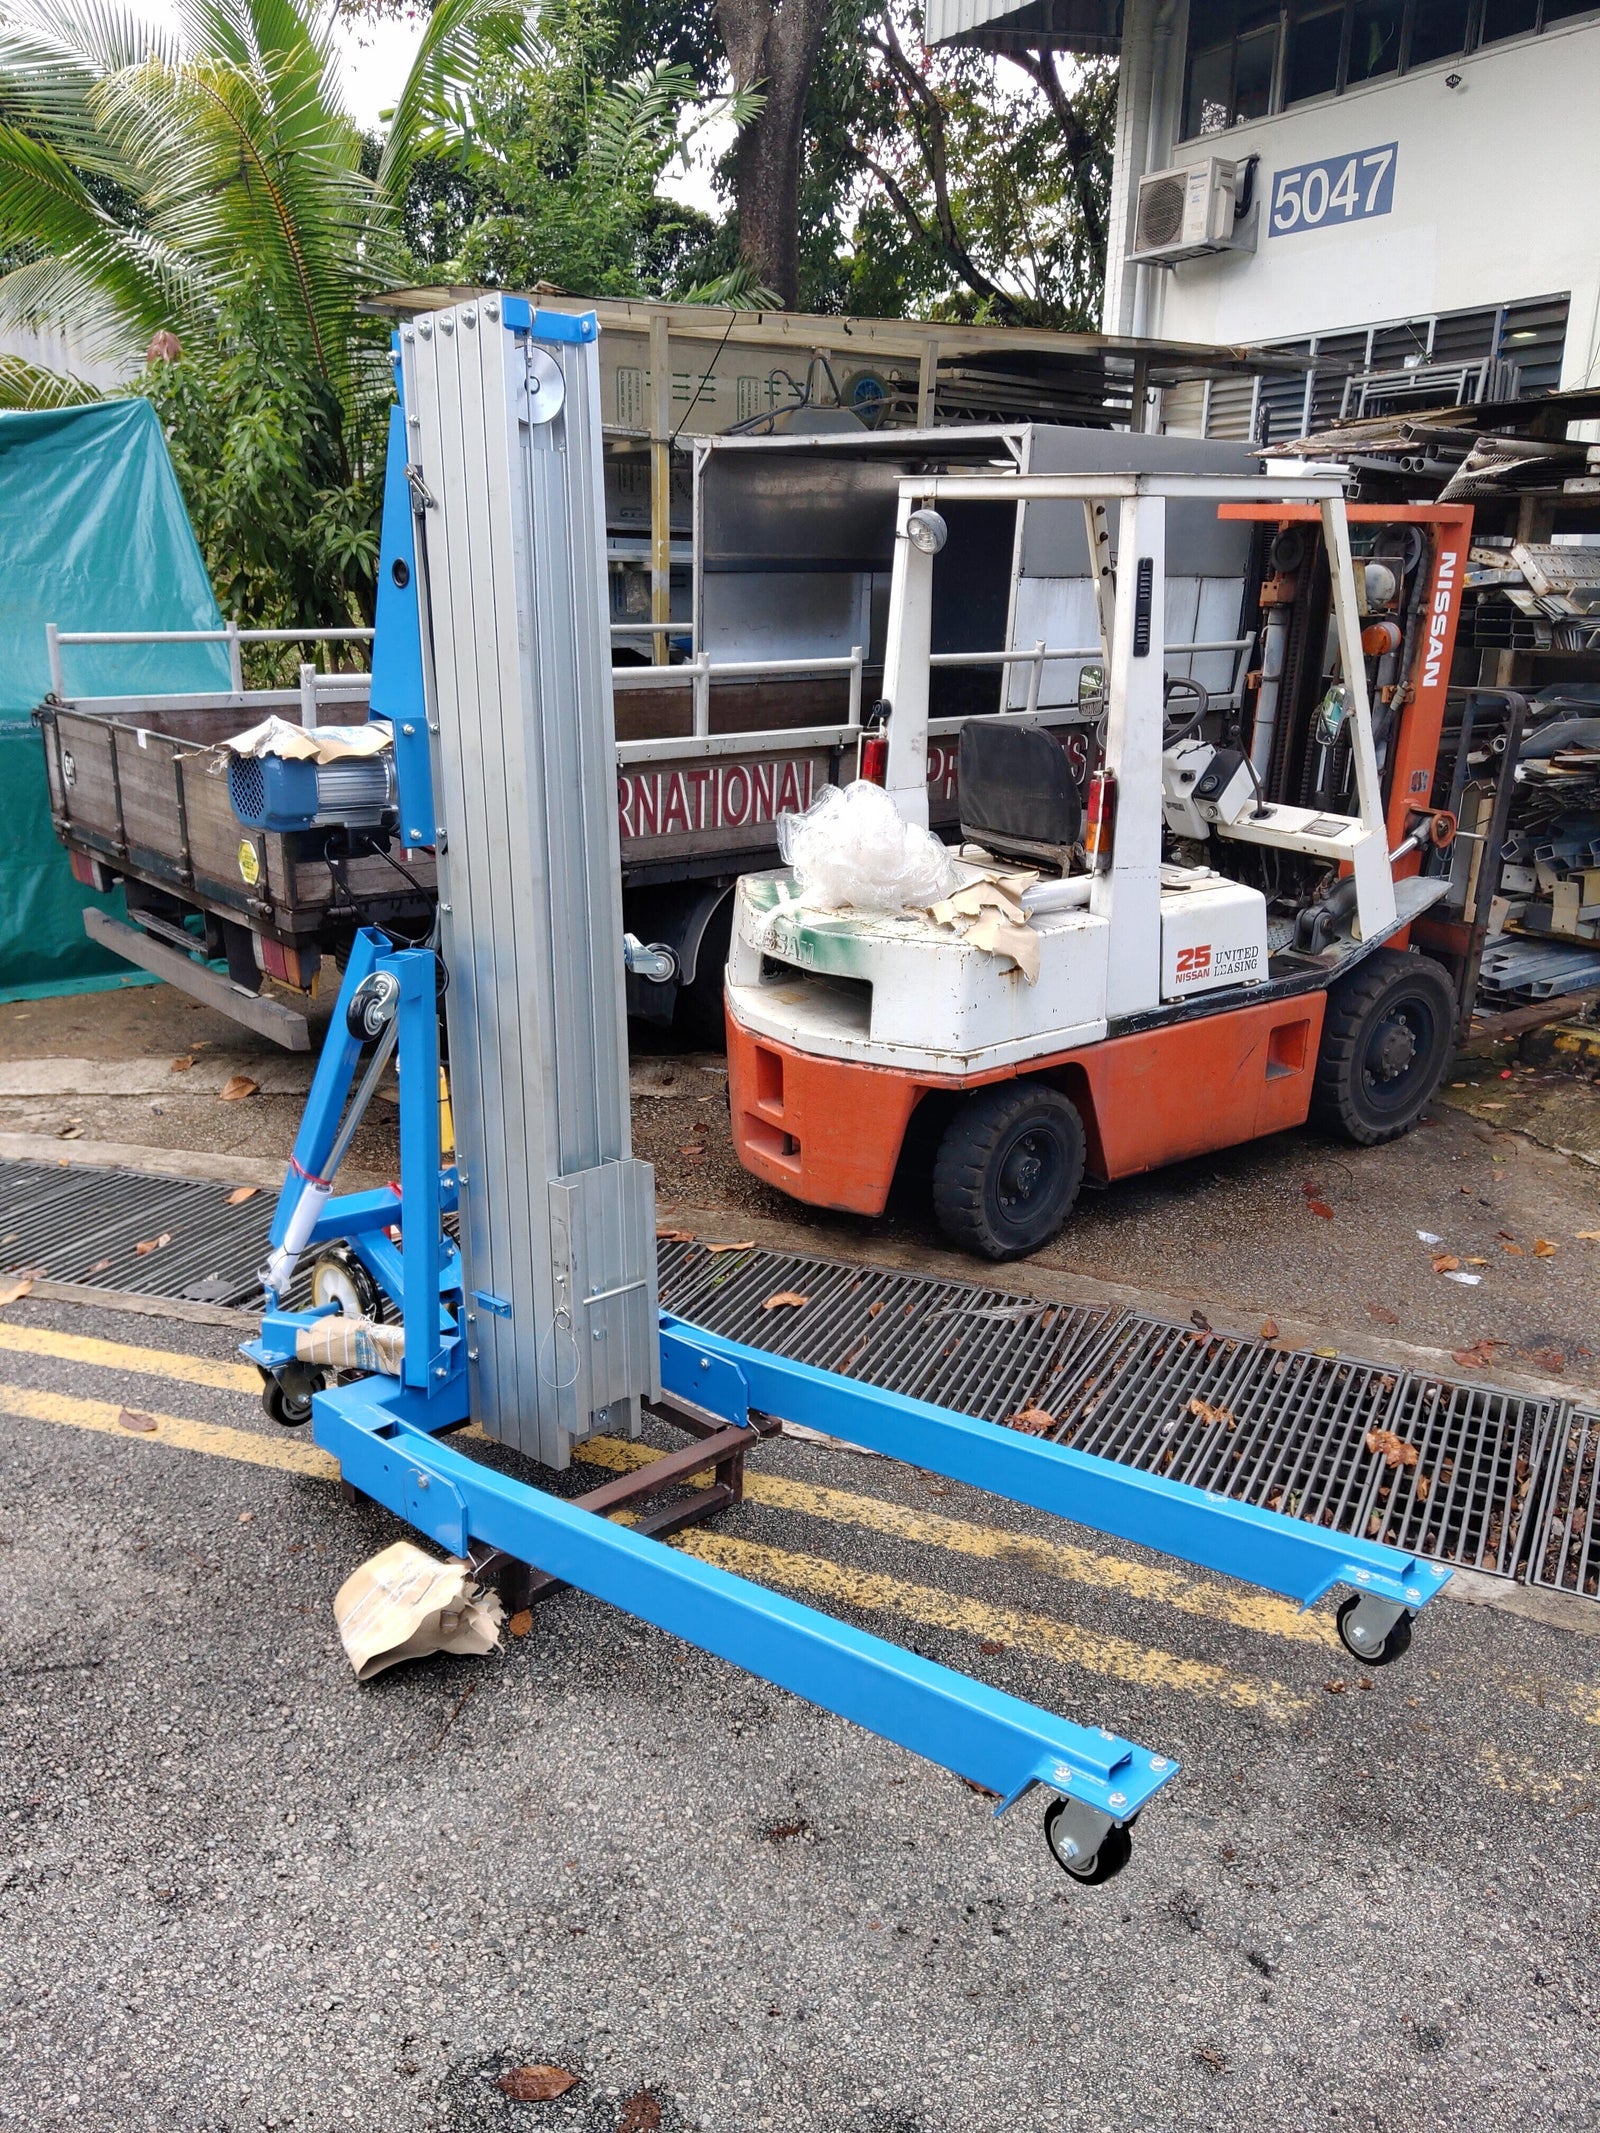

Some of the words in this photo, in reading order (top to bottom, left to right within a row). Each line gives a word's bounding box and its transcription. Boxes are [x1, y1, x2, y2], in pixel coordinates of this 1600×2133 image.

[1274, 149, 1393, 230] 5047
[1422, 551, 1457, 687] NISSAN
[1176, 944, 1212, 973] 25
[1215, 945, 1259, 964] UNITED
[1175, 967, 1211, 984] NISSAN
[1213, 958, 1258, 977] LEASING
